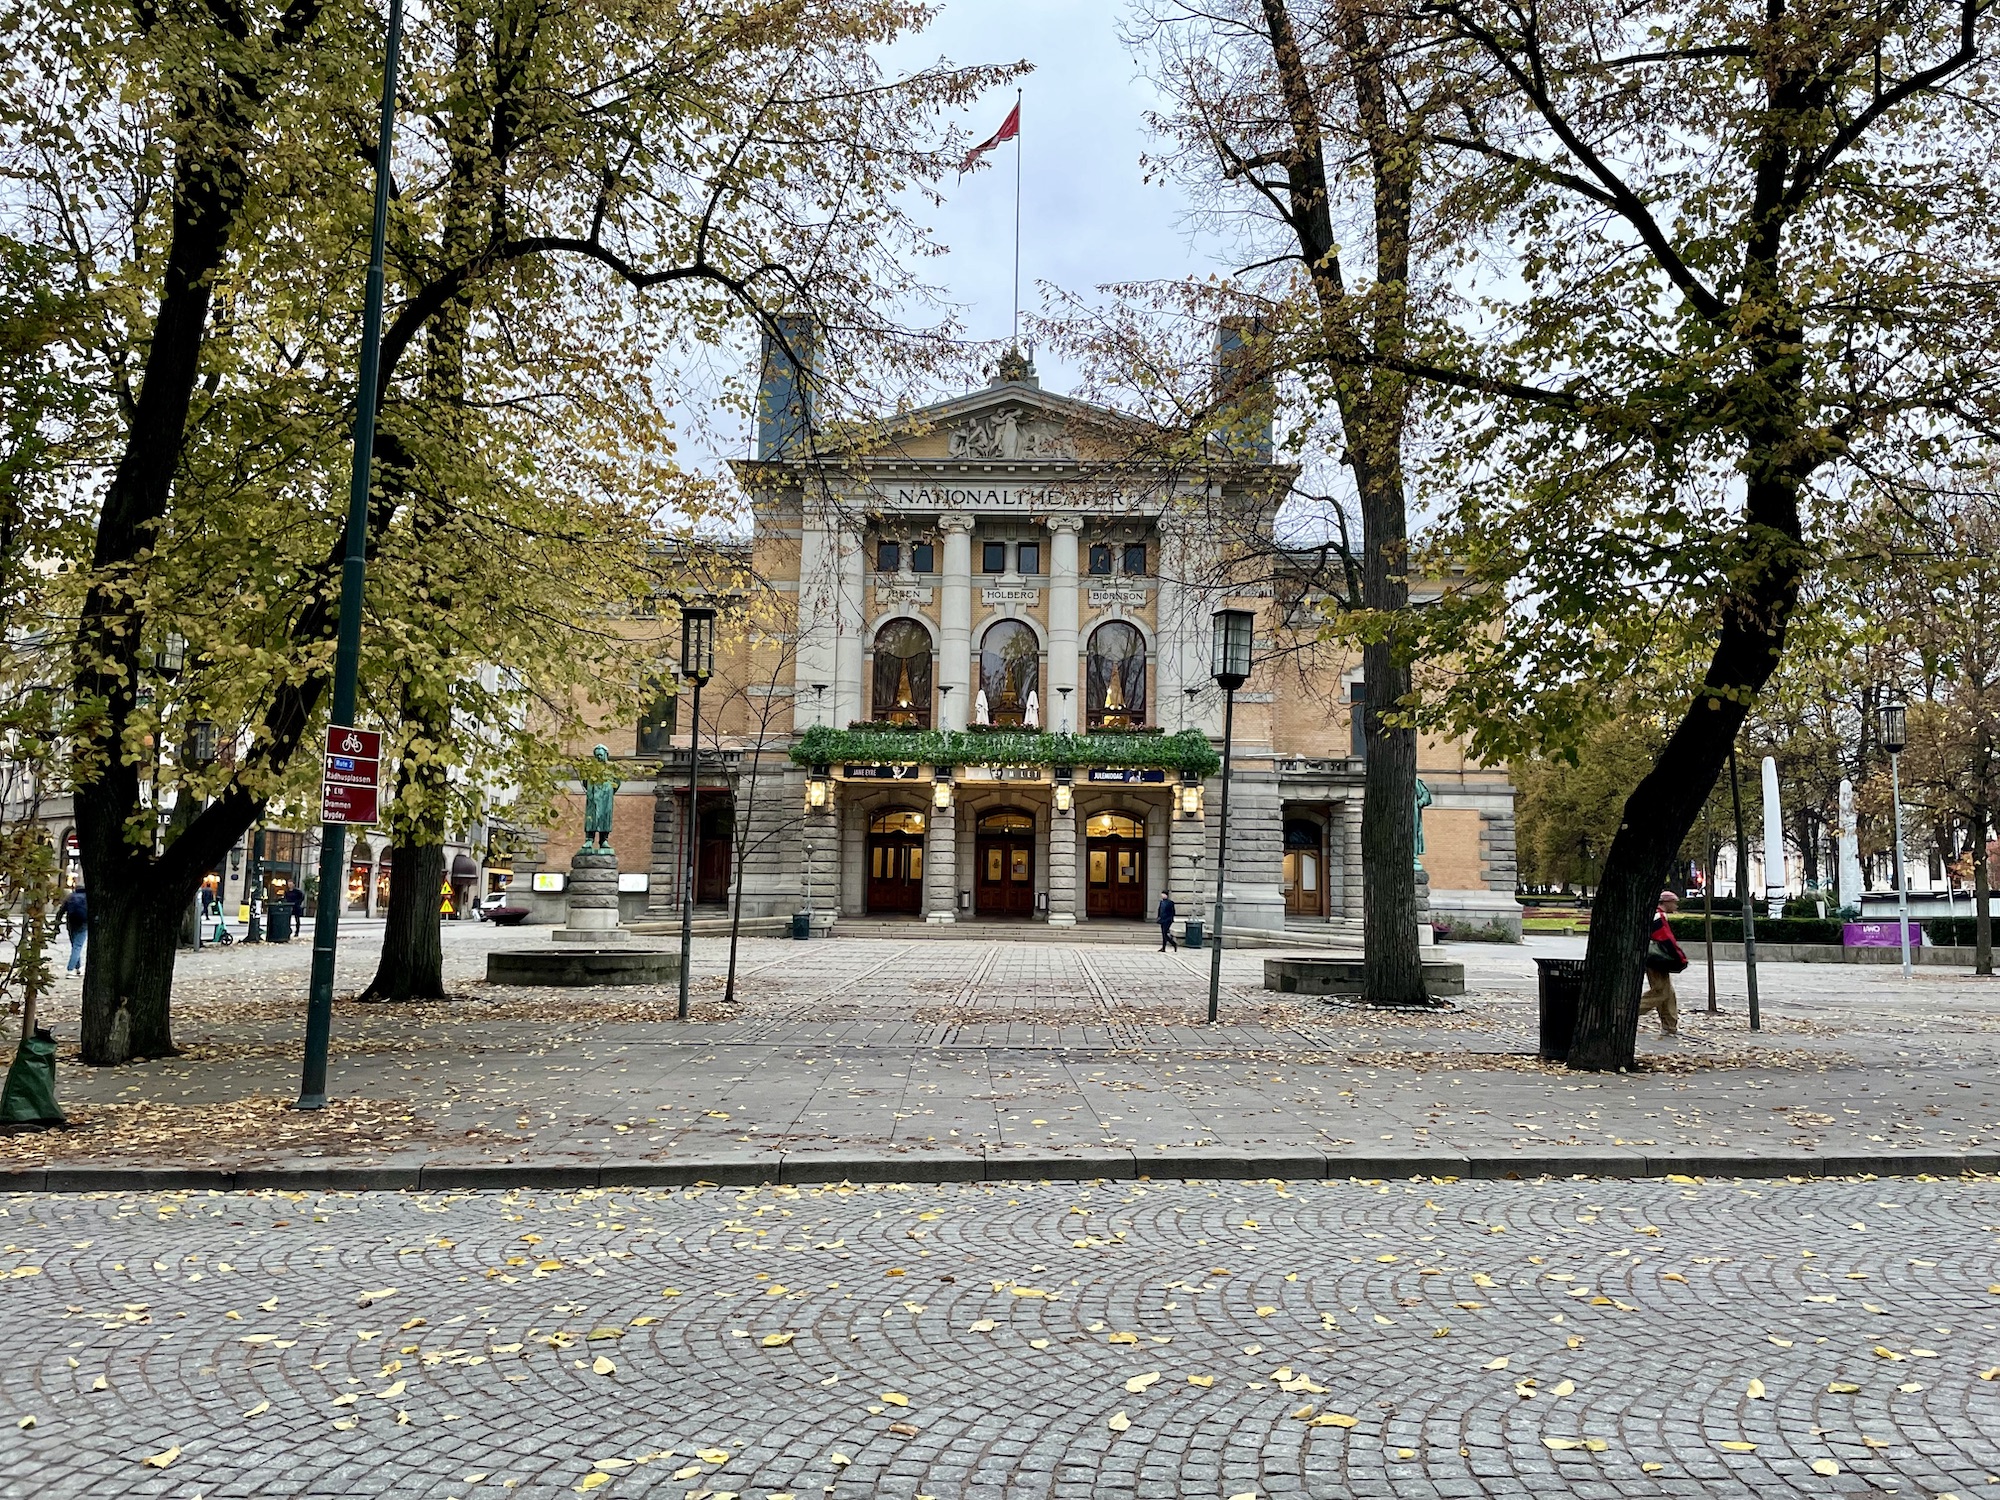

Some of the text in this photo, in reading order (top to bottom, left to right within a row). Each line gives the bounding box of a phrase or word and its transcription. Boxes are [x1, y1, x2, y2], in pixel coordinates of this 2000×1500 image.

[987, 591, 1034, 599] HOLBERG
[853, 768, 876, 776] JANE EYRE
[1094, 772, 1123, 780] JULEMIDDAG
[326, 771, 371, 783] Rådhusplassen
[325, 799, 351, 809] Drammen
[324, 810, 346, 820] Bygdøy
